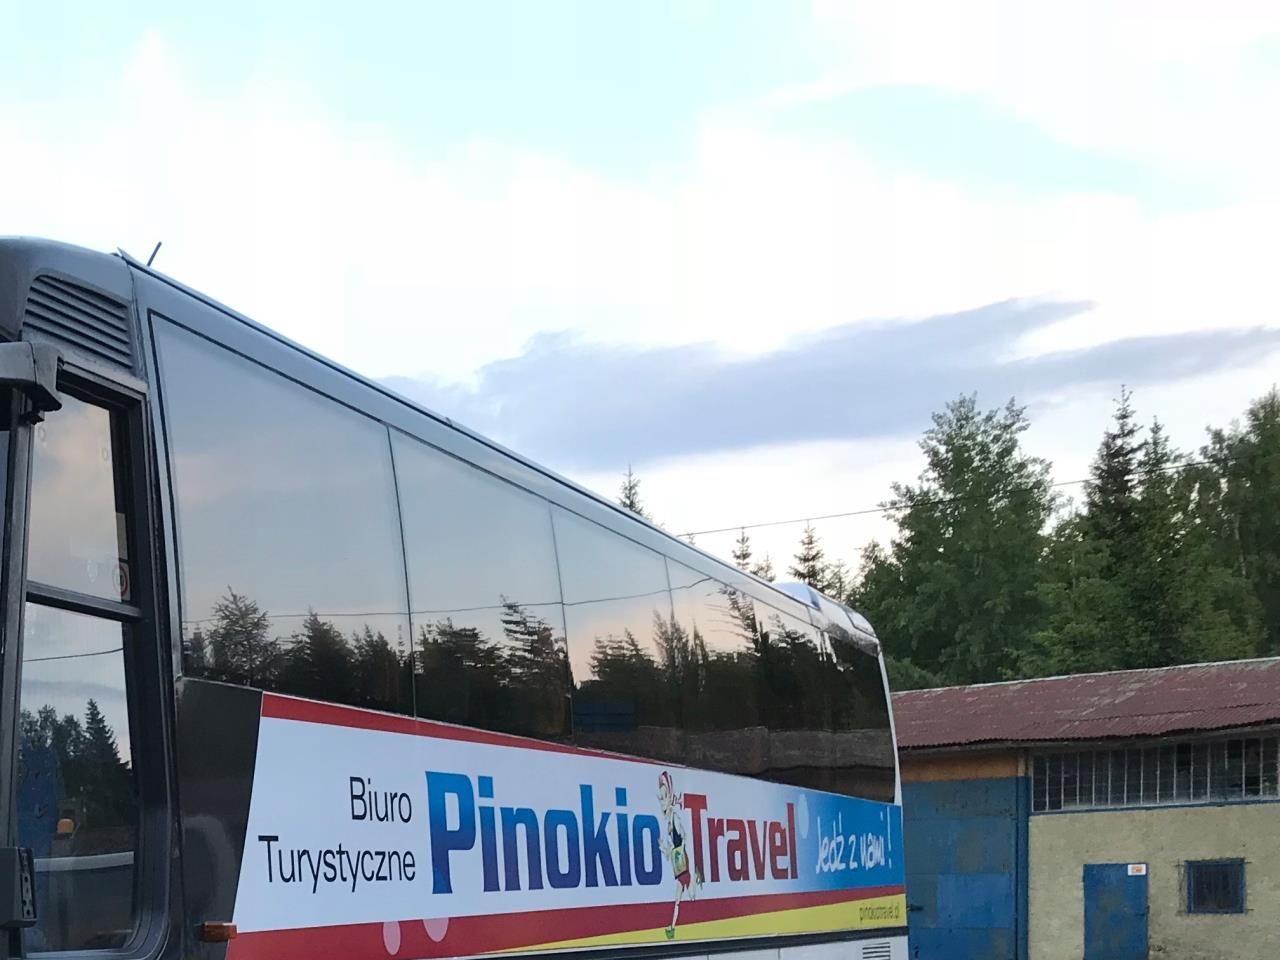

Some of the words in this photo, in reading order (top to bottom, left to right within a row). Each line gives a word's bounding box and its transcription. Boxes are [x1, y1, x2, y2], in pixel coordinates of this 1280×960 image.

[350, 776, 412, 823] Biuro
[425, 771, 663, 894] Pinokio
[683, 793, 799, 884] Travel
[258, 835, 416, 894] Turystyczne
